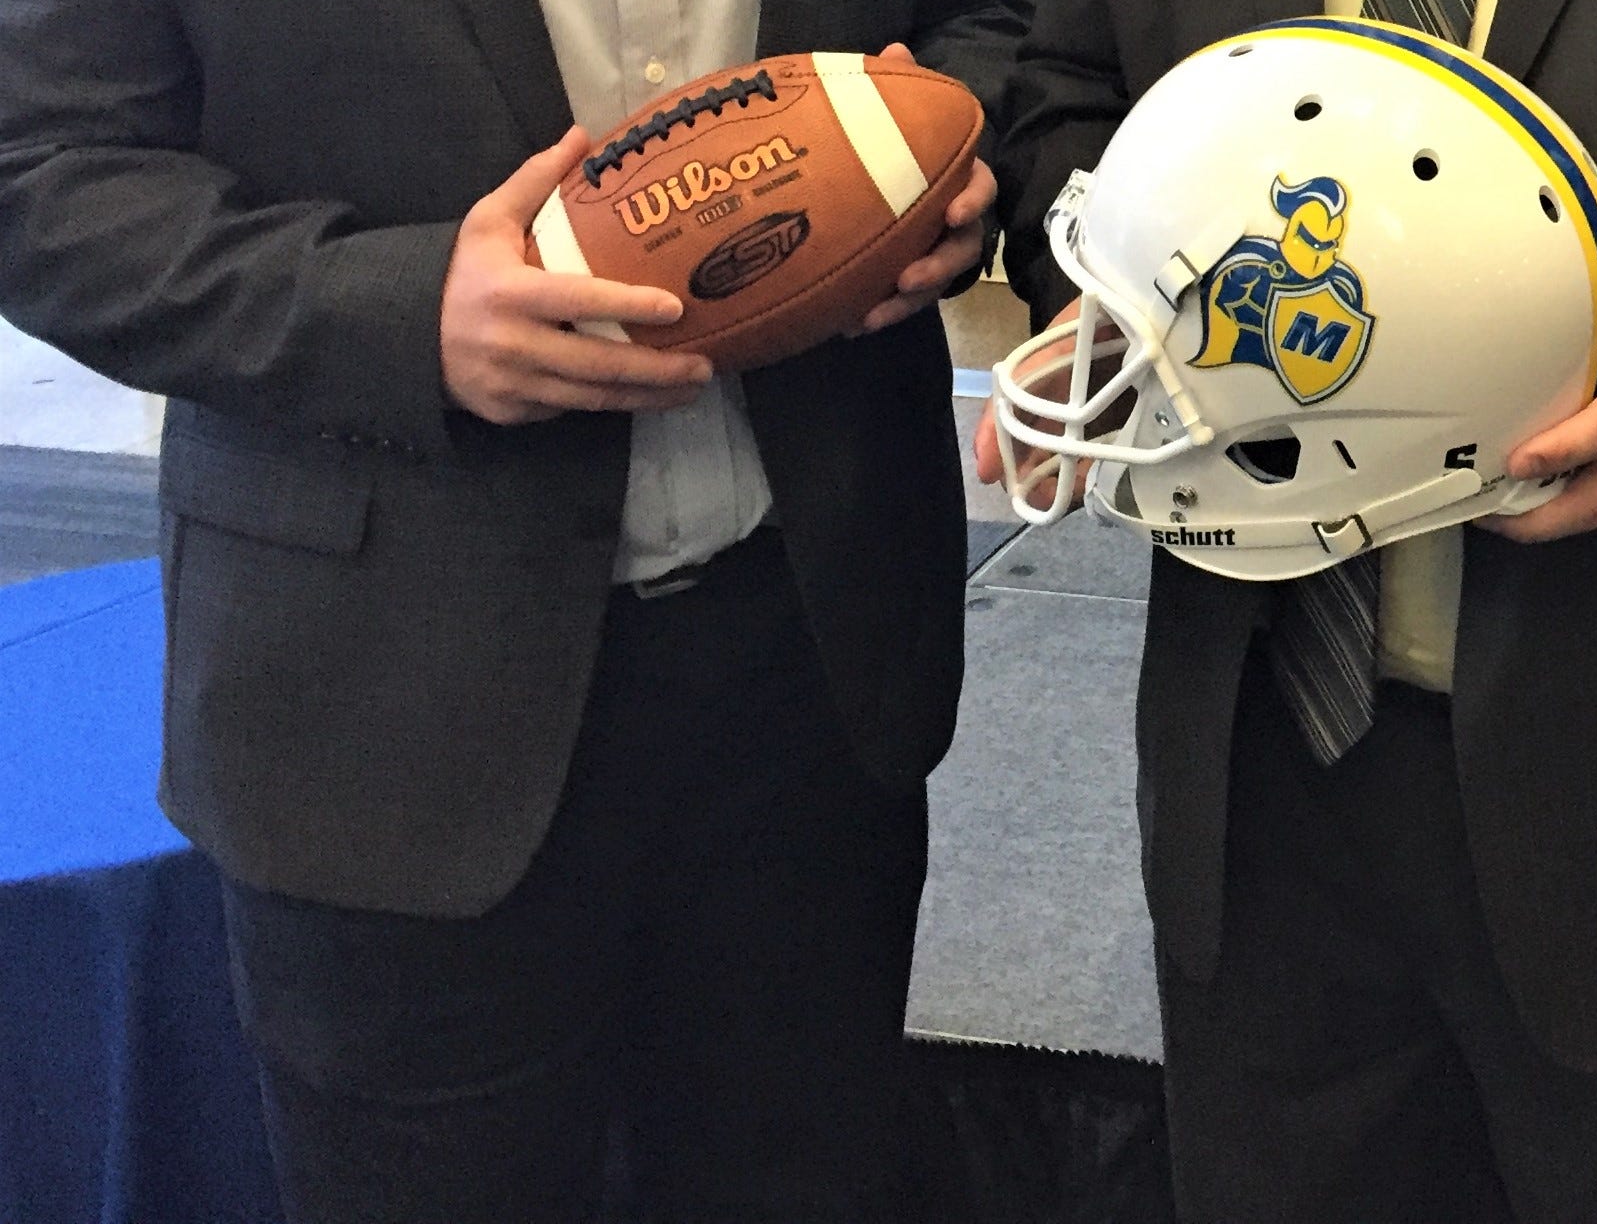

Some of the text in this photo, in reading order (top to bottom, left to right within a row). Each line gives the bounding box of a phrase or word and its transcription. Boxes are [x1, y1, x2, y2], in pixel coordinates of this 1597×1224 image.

[613, 136, 797, 235] Wilson
[1282, 311, 1350, 364] M
[1151, 527, 1236, 547] schutt
